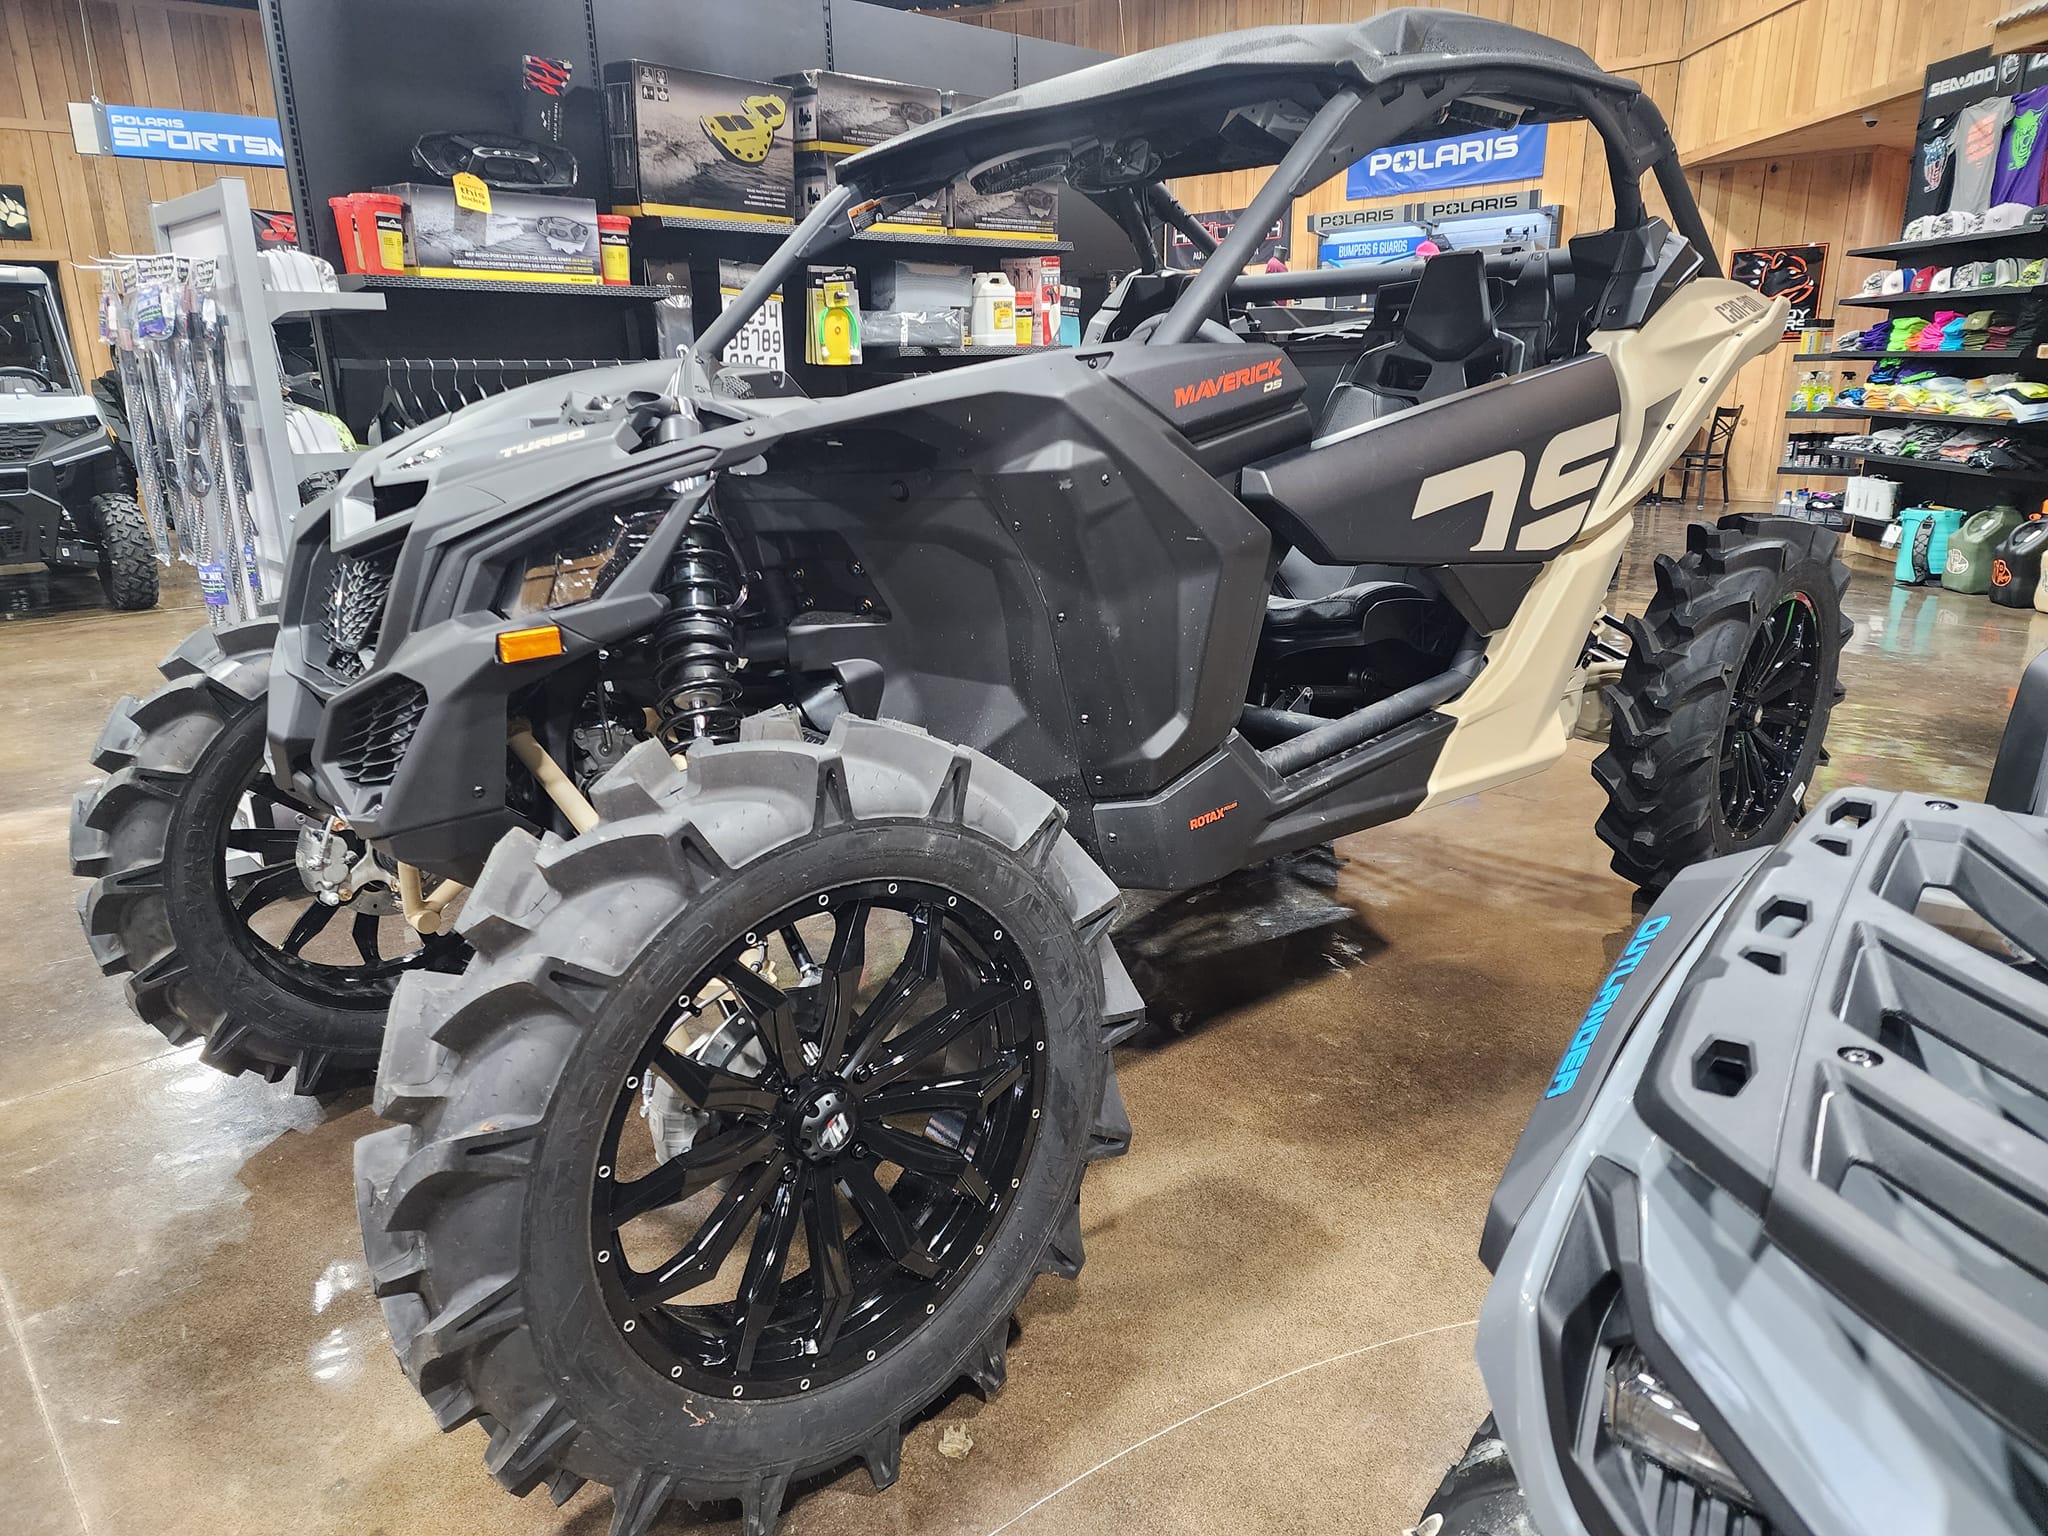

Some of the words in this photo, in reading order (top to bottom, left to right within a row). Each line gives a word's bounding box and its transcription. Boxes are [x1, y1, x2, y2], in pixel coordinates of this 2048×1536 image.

[111, 114, 185, 129] POLARIS
[1369, 134, 1519, 177] POLARIS
[1432, 195, 1518, 216] POLARIS
[1320, 209, 1394, 228] POLARIS
[1338, 242, 1371, 258] BUMPERS
[1372, 242, 1378, 255] &
[1379, 239, 1408, 254] GUARDS
[1174, 358, 1282, 408] MAVERICK
[1263, 378, 1283, 393] DS
[500, 429, 585, 457] TURBO
[1189, 807, 1225, 831] ROTAX
[1546, 914, 1672, 1099] OUTLANDER
